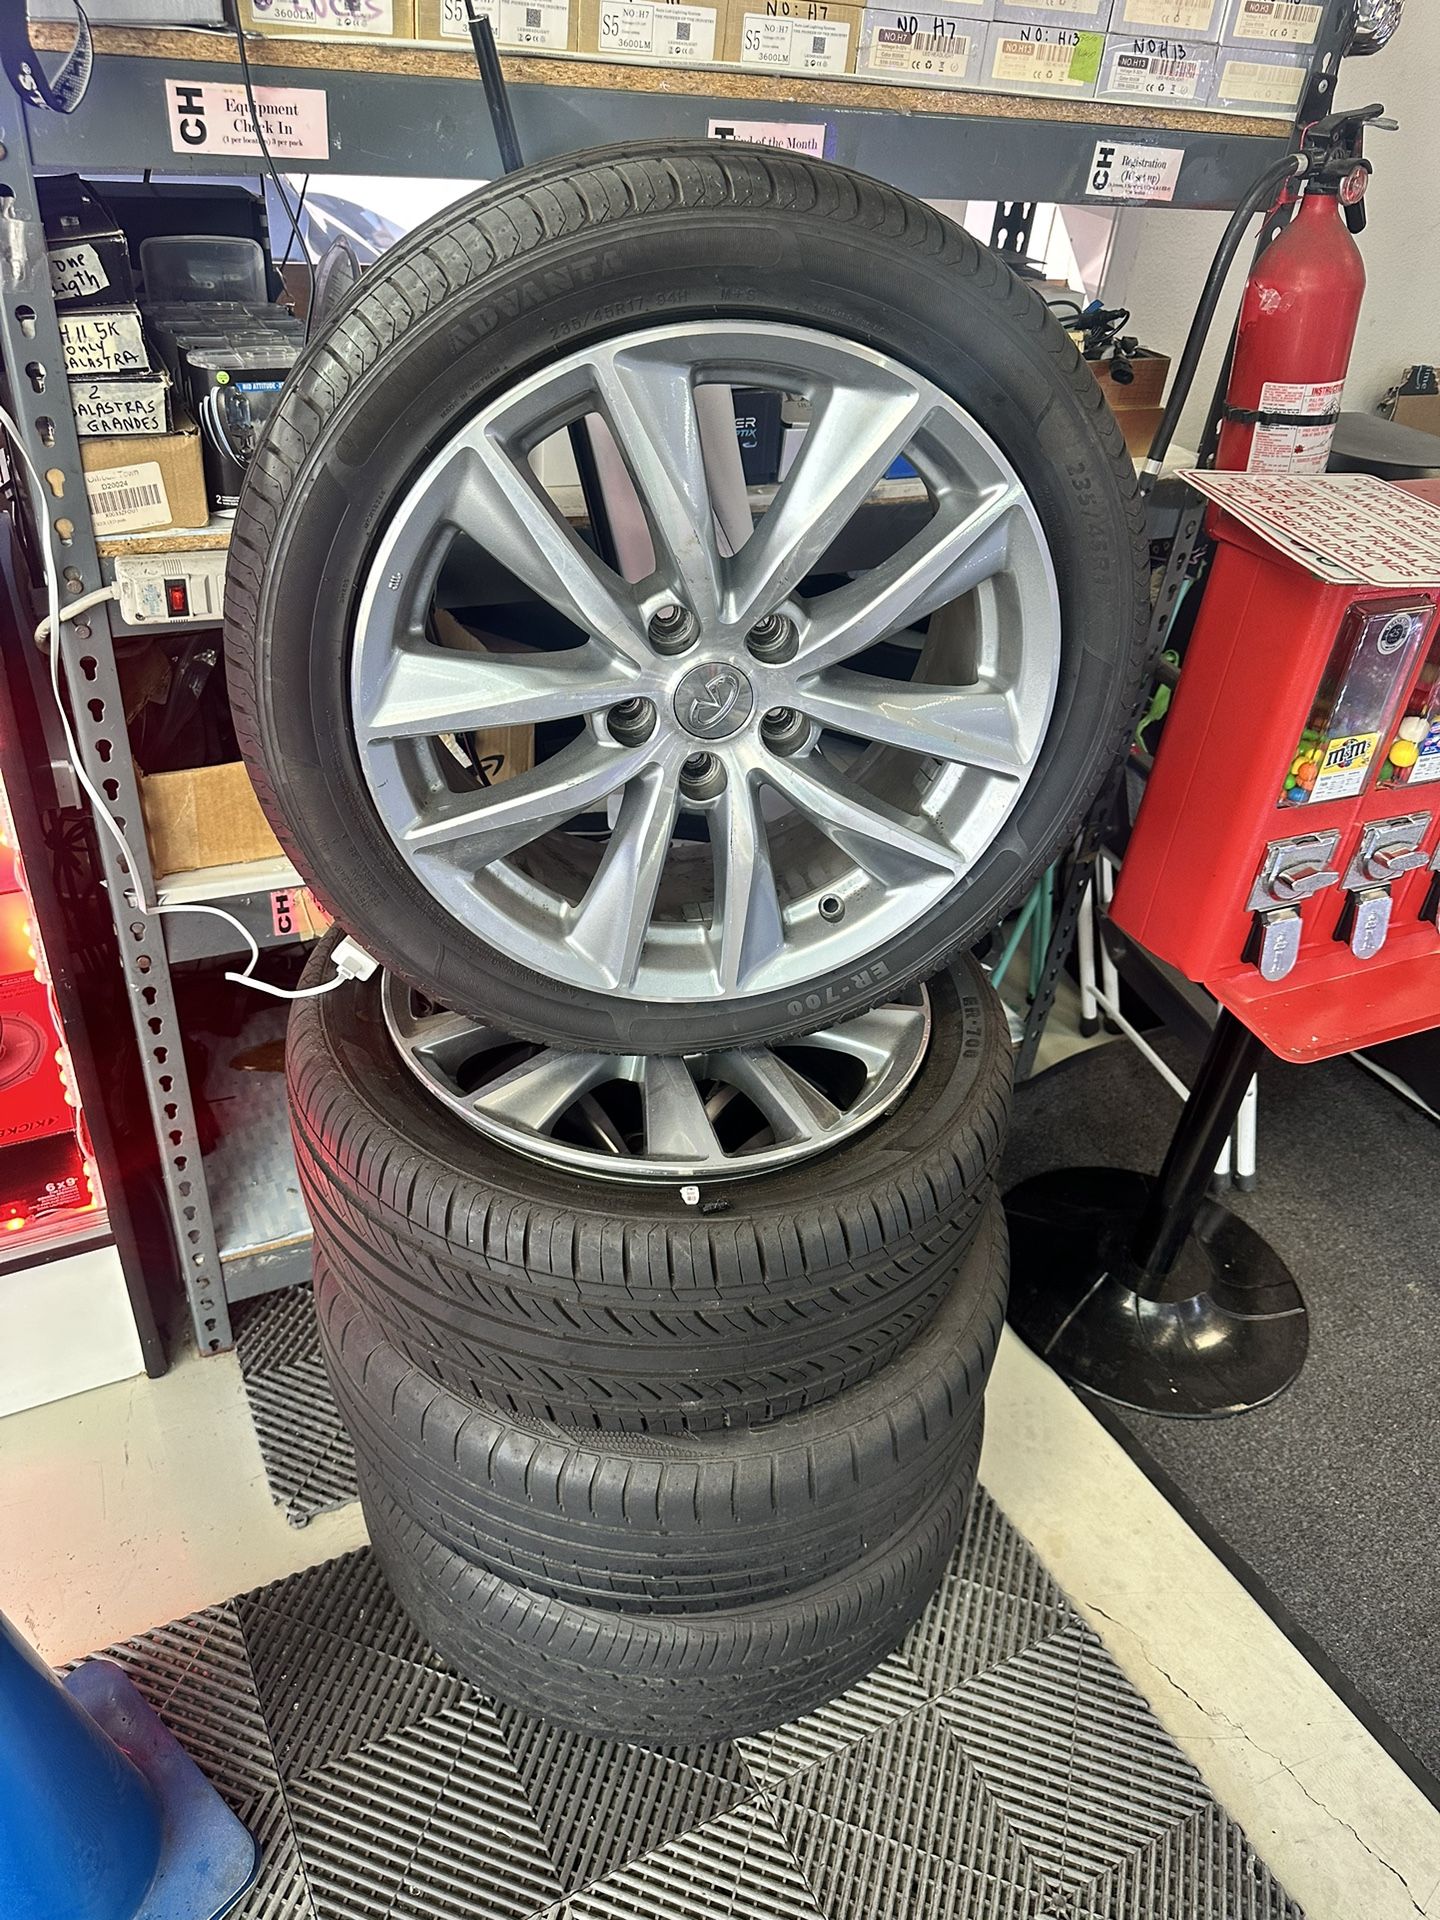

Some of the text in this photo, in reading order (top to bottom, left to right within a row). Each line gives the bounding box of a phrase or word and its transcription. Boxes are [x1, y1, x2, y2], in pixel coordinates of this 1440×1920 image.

[274, 8, 314, 20] 3600LM
[808, 3, 828, 20] H7
[602, 14, 620, 37] S5
[898, 16, 956, 40] NO H7
[618, 38, 650, 49] 3600LM
[745, 29, 761, 51] S5
[1058, 31, 1080, 46] H13
[759, 52, 789, 62] 3600LM
[176, 87, 207, 146] CH
[225, 98, 299, 117] Equipment
[278, 121, 293, 135] In
[768, 136, 784, 148] the
[786, 137, 818, 150] Month
[1092, 147, 1115, 191] CH
[1121, 155, 1167, 170] Registration
[94, 321, 120, 340] 5K
[63, 350, 140, 370] ALASTRA
[88, 385, 101, 400] 2
[72, 400, 156, 418] ALASTRAS
[86, 416, 159, 433] GRANDES
[1310, 479, 1397, 518] INSURANCE
[1340, 512, 1372, 524] NO
[1254, 504, 1375, 569] ASEGURADORA
[1290, 511, 1420, 577] REGULACIONES
[1293, 499, 1339, 520] AREA
[1334, 521, 1365, 533] DE
[1359, 534, 1440, 575] TRABAJO
[275, 895, 292, 934] CH
[786, 960, 891, 1017] ER-700
[962, 996, 982, 1059] ER-700
